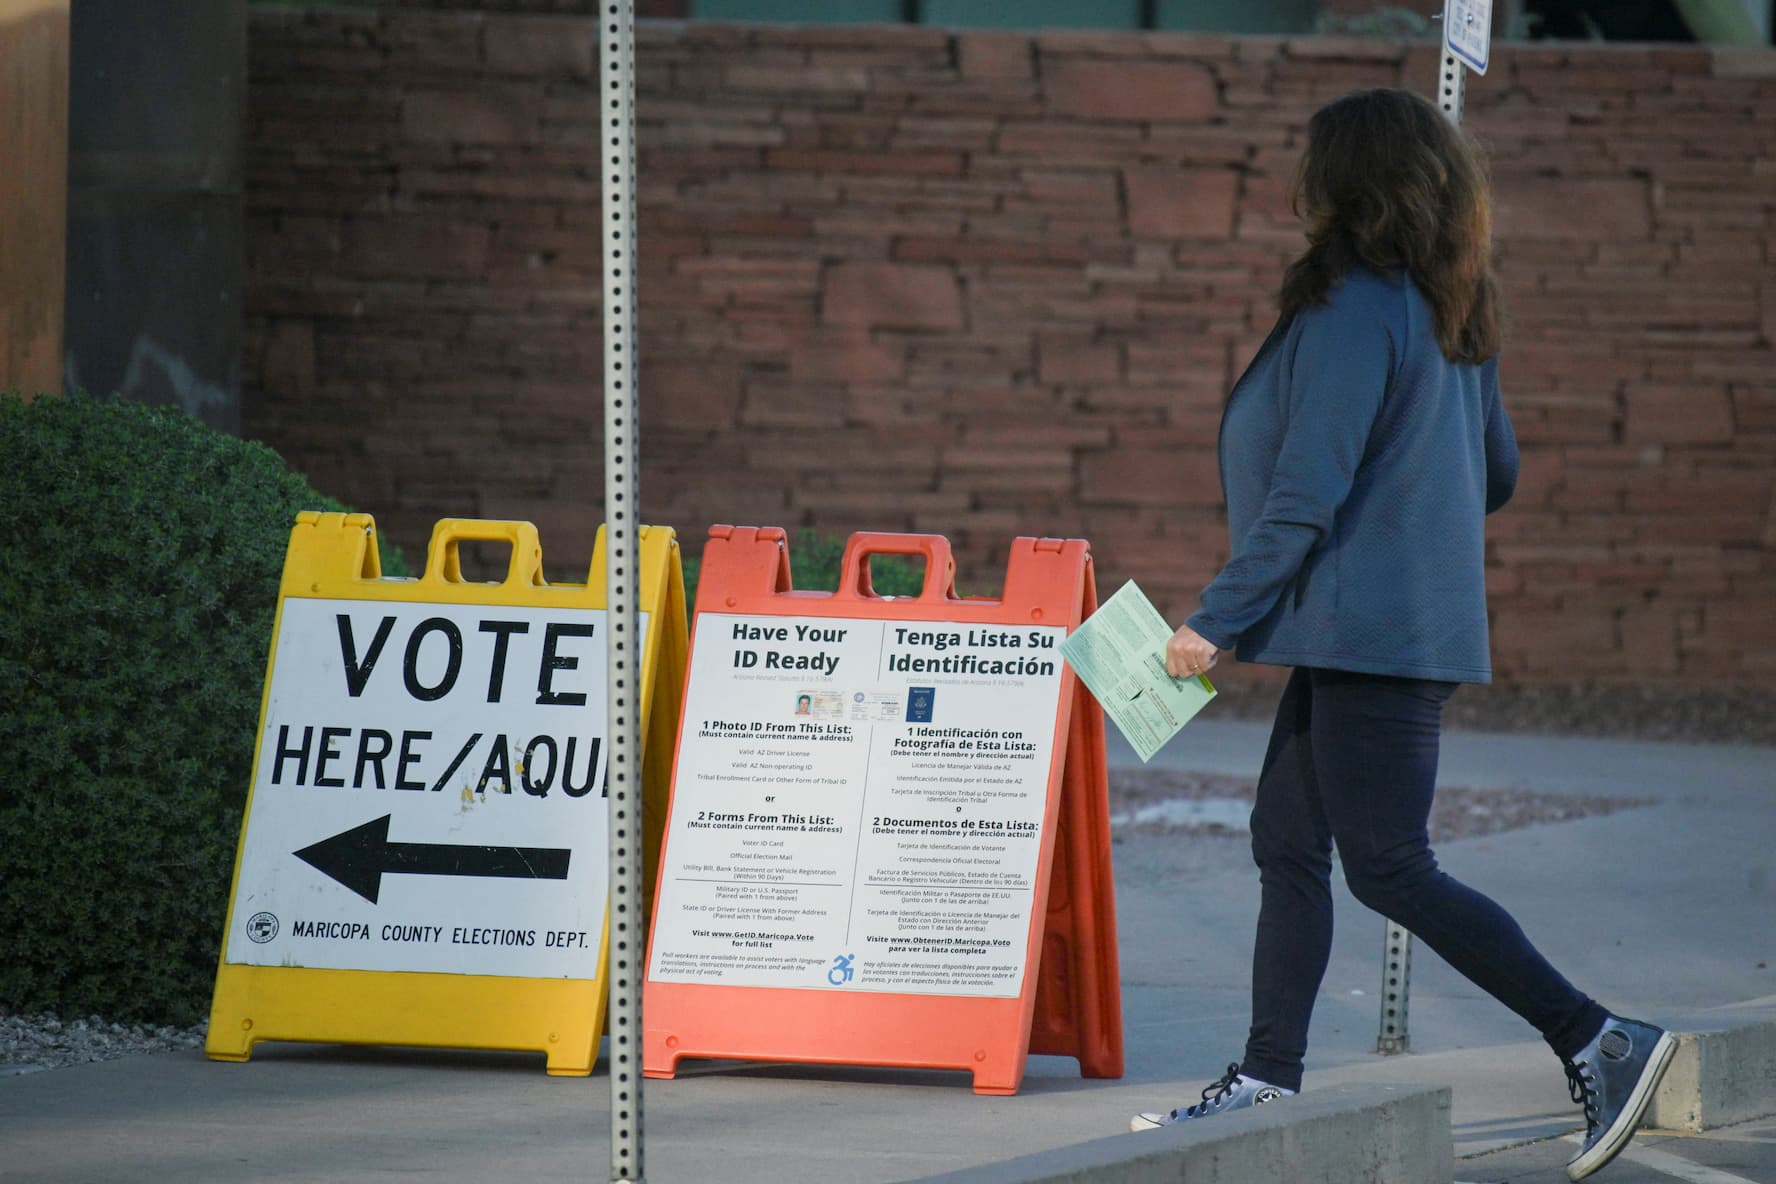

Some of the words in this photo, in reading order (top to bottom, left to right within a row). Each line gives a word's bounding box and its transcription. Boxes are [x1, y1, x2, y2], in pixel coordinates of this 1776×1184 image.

[732, 623, 788, 641] Have
[795, 624, 848, 643] Your
[895, 628, 961, 651] Tenga
[967, 629, 1021, 648] Lista
[1027, 631, 1054, 649] Su
[336, 614, 594, 706] VOTE
[733, 649, 758, 668] ID
[764, 650, 840, 676] Ready
[888, 653, 1054, 676] Identificación
[703, 720, 708, 729] 1
[711, 720, 747, 731] Photo
[749, 721, 762, 731] ID
[765, 722, 796, 732] From
[799, 723, 823, 733] This
[826, 723, 852, 734] List:
[907, 726, 913, 736] 1
[916, 727, 998, 739] Identificación
[1001, 731, 1023, 739] con
[698, 729, 722, 738] (Must
[723, 731, 754, 739] contain
[810, 733, 817, 741] &
[818, 734, 853, 743] address)
[894, 737, 955, 750] Fotografía
[958, 739, 973, 750] de
[975, 740, 1001, 750] Esta
[1003, 740, 1036, 751] Lista:
[975, 751, 1008, 759] dirección
[1009, 752, 1035, 760] actual)
[955, 805, 962, 813] o
[697, 811, 705, 820] 2
[707, 811, 745, 822] Forms
[747, 812, 778, 823] From
[781, 813, 806, 824] This
[808, 814, 834, 825] List:
[872, 816, 880, 825] 2
[882, 816, 958, 828] Documentos
[960, 818, 975, 829] de
[978, 819, 1003, 829] Esta
[1006, 819, 1039, 831] Lista:
[687, 820, 711, 829] (Must
[712, 822, 743, 830] contain
[799, 824, 806, 832] &
[807, 825, 843, 834] address)
[871, 826, 896, 834] (Debe
[896, 827, 919, 835] tener
[929, 828, 961, 836] nombre
[962, 830, 968, 838] y
[968, 829, 1006, 837] dirección
[1006, 831, 1035, 839] actual)
[292, 921, 370, 940] MARICOPA
[381, 925, 442, 943] COUNTY
[452, 928, 535, 946] ELECTIONS
[545, 931, 589, 949] DEPT.
[691, 929, 710, 937] Visit
[711, 931, 814, 942] www.GetID.Maricopa.Vote
[866, 935, 889, 943] Visite
[889, 936, 1011, 948] www.ObtenerID.Maricopa.Voto
[731, 939, 743, 947] for
[744, 940, 759, 948] full
[759, 940, 772, 948] list
[922, 945, 930, 953] la
[949, 946, 987, 956] completa
